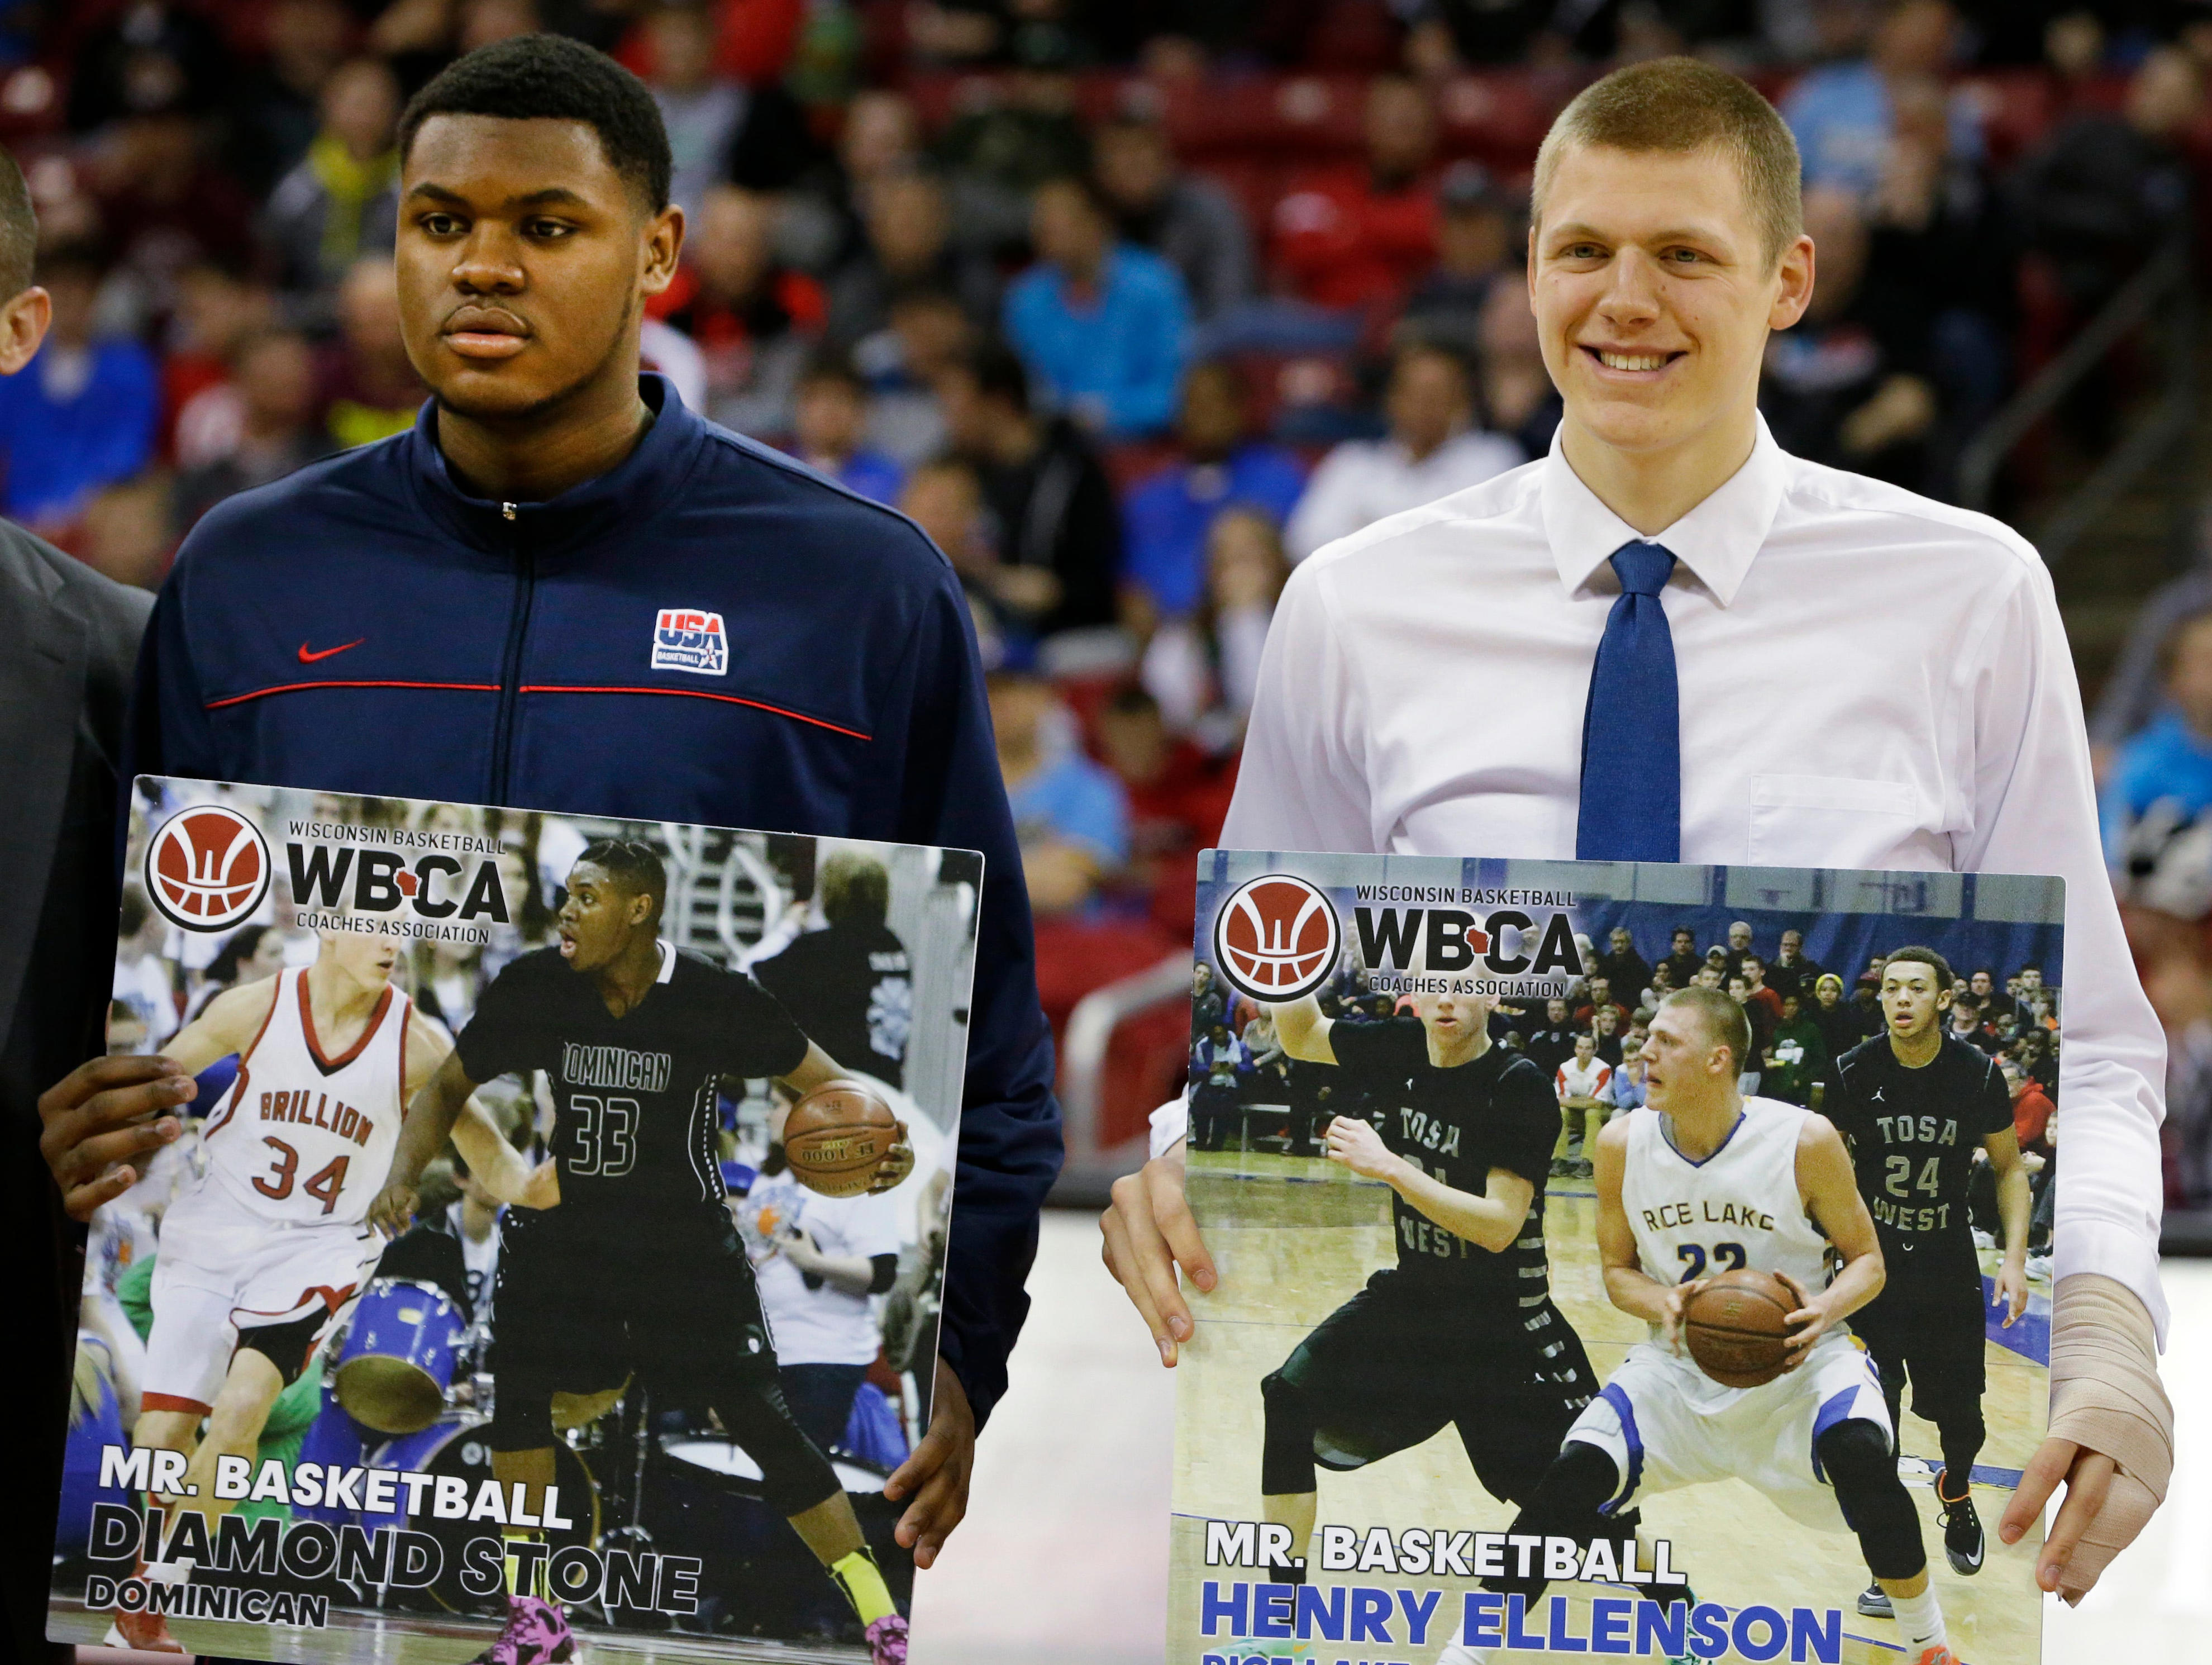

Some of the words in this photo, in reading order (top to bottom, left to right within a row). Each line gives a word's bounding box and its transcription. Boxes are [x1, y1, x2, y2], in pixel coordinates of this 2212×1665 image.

[657, 650, 699, 663] BASKETBALL
[660, 613, 723, 651] USA
[289, 820, 388, 845] WISCONSIN
[394, 830, 507, 855] BASKETBALL
[286, 843, 510, 924] WBCA
[1356, 884, 1455, 903] WISCONSIN
[1462, 888, 1577, 907] BASKETBALL
[297, 912, 374, 934] COACHES
[380, 921, 489, 944] ASSOCIATION
[1353, 907, 1584, 976] WBCA
[1369, 976, 1447, 994] COACHES
[1453, 979, 1564, 997] ASSOCIATION
[562, 1041, 671, 1092] OMINICAN
[260, 1090, 374, 1147] BRILLION
[569, 1094, 640, 1176] 33
[1400, 1107, 1460, 1158] TOSA
[1877, 1115, 1957, 1146] TOSA
[251, 1135, 350, 1216] 34
[1885, 1155, 1940, 1198] 24
[1873, 1196, 1950, 1231] WEST
[99, 1444, 199, 1496] MR.
[214, 1454, 573, 1530] BASKETBALL
[88, 1502, 444, 1588] DIAMOND
[460, 1537, 702, 1615] STONE
[1205, 1521, 1305, 1568] MR.
[1322, 1525, 1687, 1585] BASKETBALL
[84, 1574, 329, 1629] DOMINICAN
[1201, 1581, 1442, 1644] HENRY
[1463, 1592, 1842, 1664] ELLENSON
